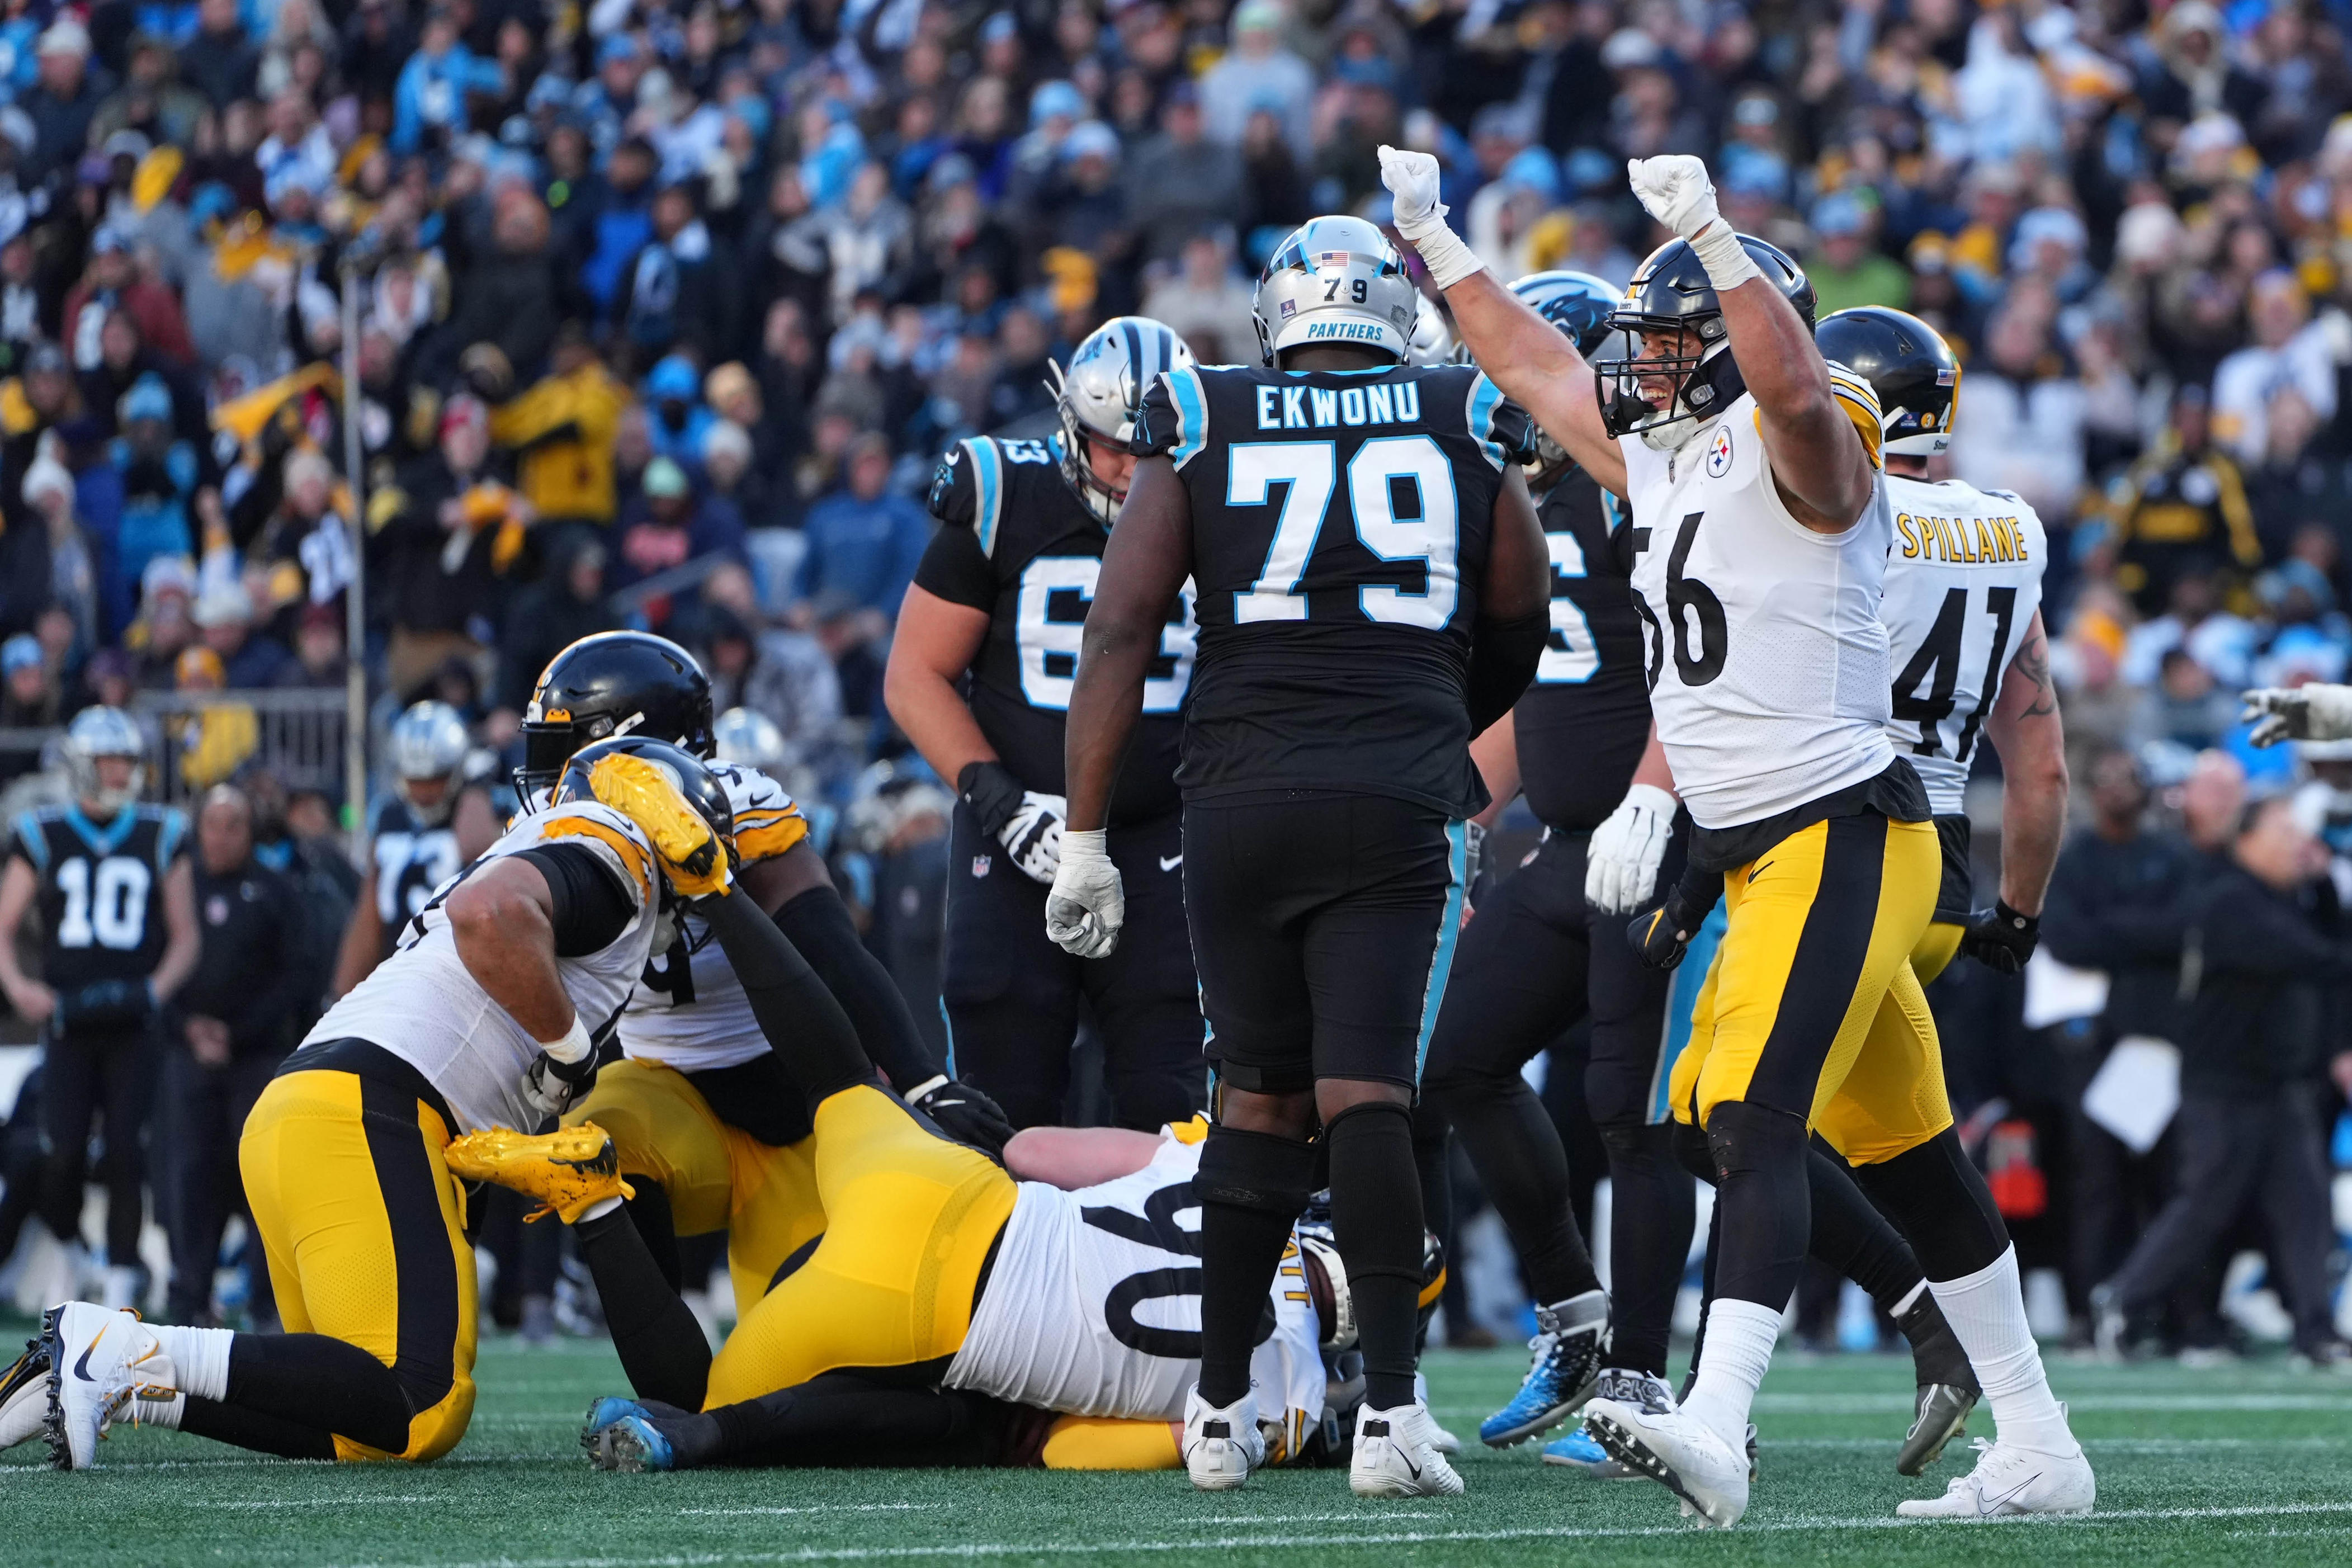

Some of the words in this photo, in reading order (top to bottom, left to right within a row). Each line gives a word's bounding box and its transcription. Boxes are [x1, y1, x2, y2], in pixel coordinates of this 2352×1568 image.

[1324, 278, 1368, 304] 79
[1308, 323, 1383, 341] PANTHERS
[1257, 381, 1421, 430] EKWONU
[1225, 434, 1460, 632] 79
[1896, 512, 2028, 563] SPILLANE
[1892, 586, 2018, 763] 41
[57, 856, 150, 950] 10
[1279, 1230, 1311, 1309] ATT
